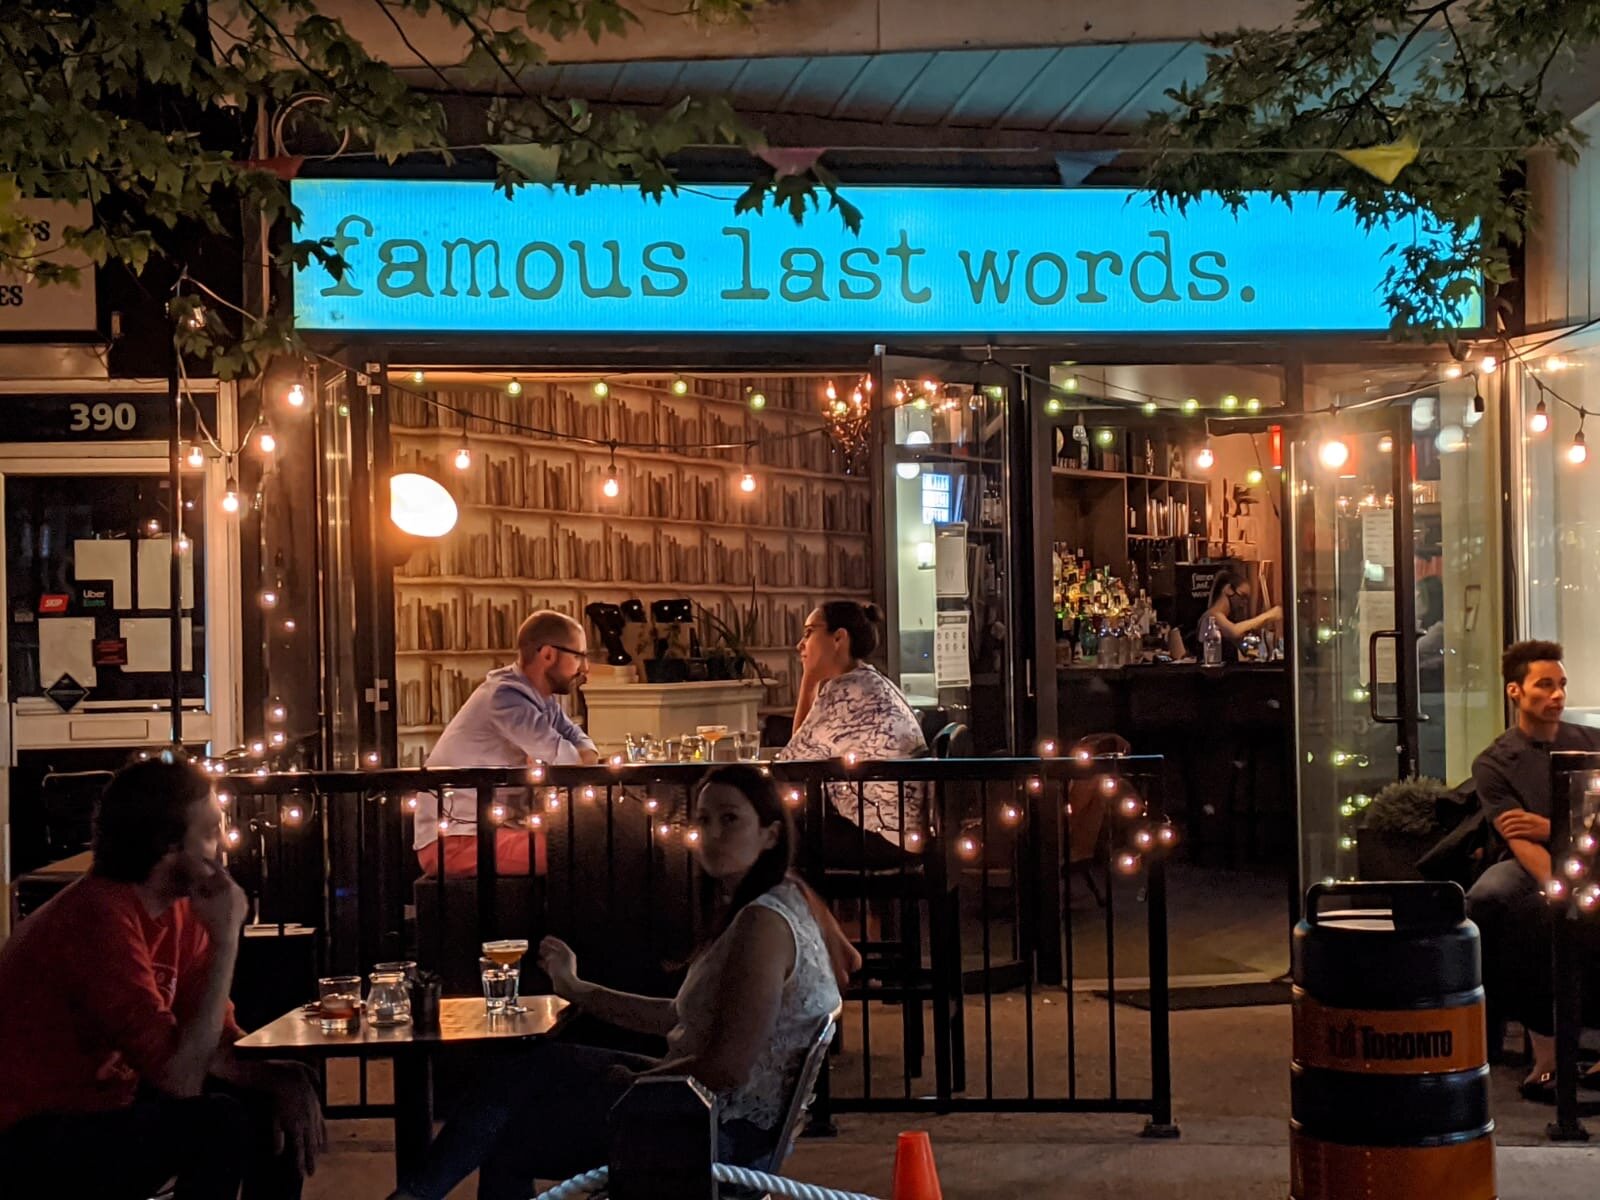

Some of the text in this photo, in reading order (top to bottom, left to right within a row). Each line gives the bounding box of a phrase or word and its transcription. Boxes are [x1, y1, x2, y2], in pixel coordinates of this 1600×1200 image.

[320, 214, 1256, 305] famous last words.
[69, 402, 137, 431] 390
[82, 589, 105, 599] Uber
